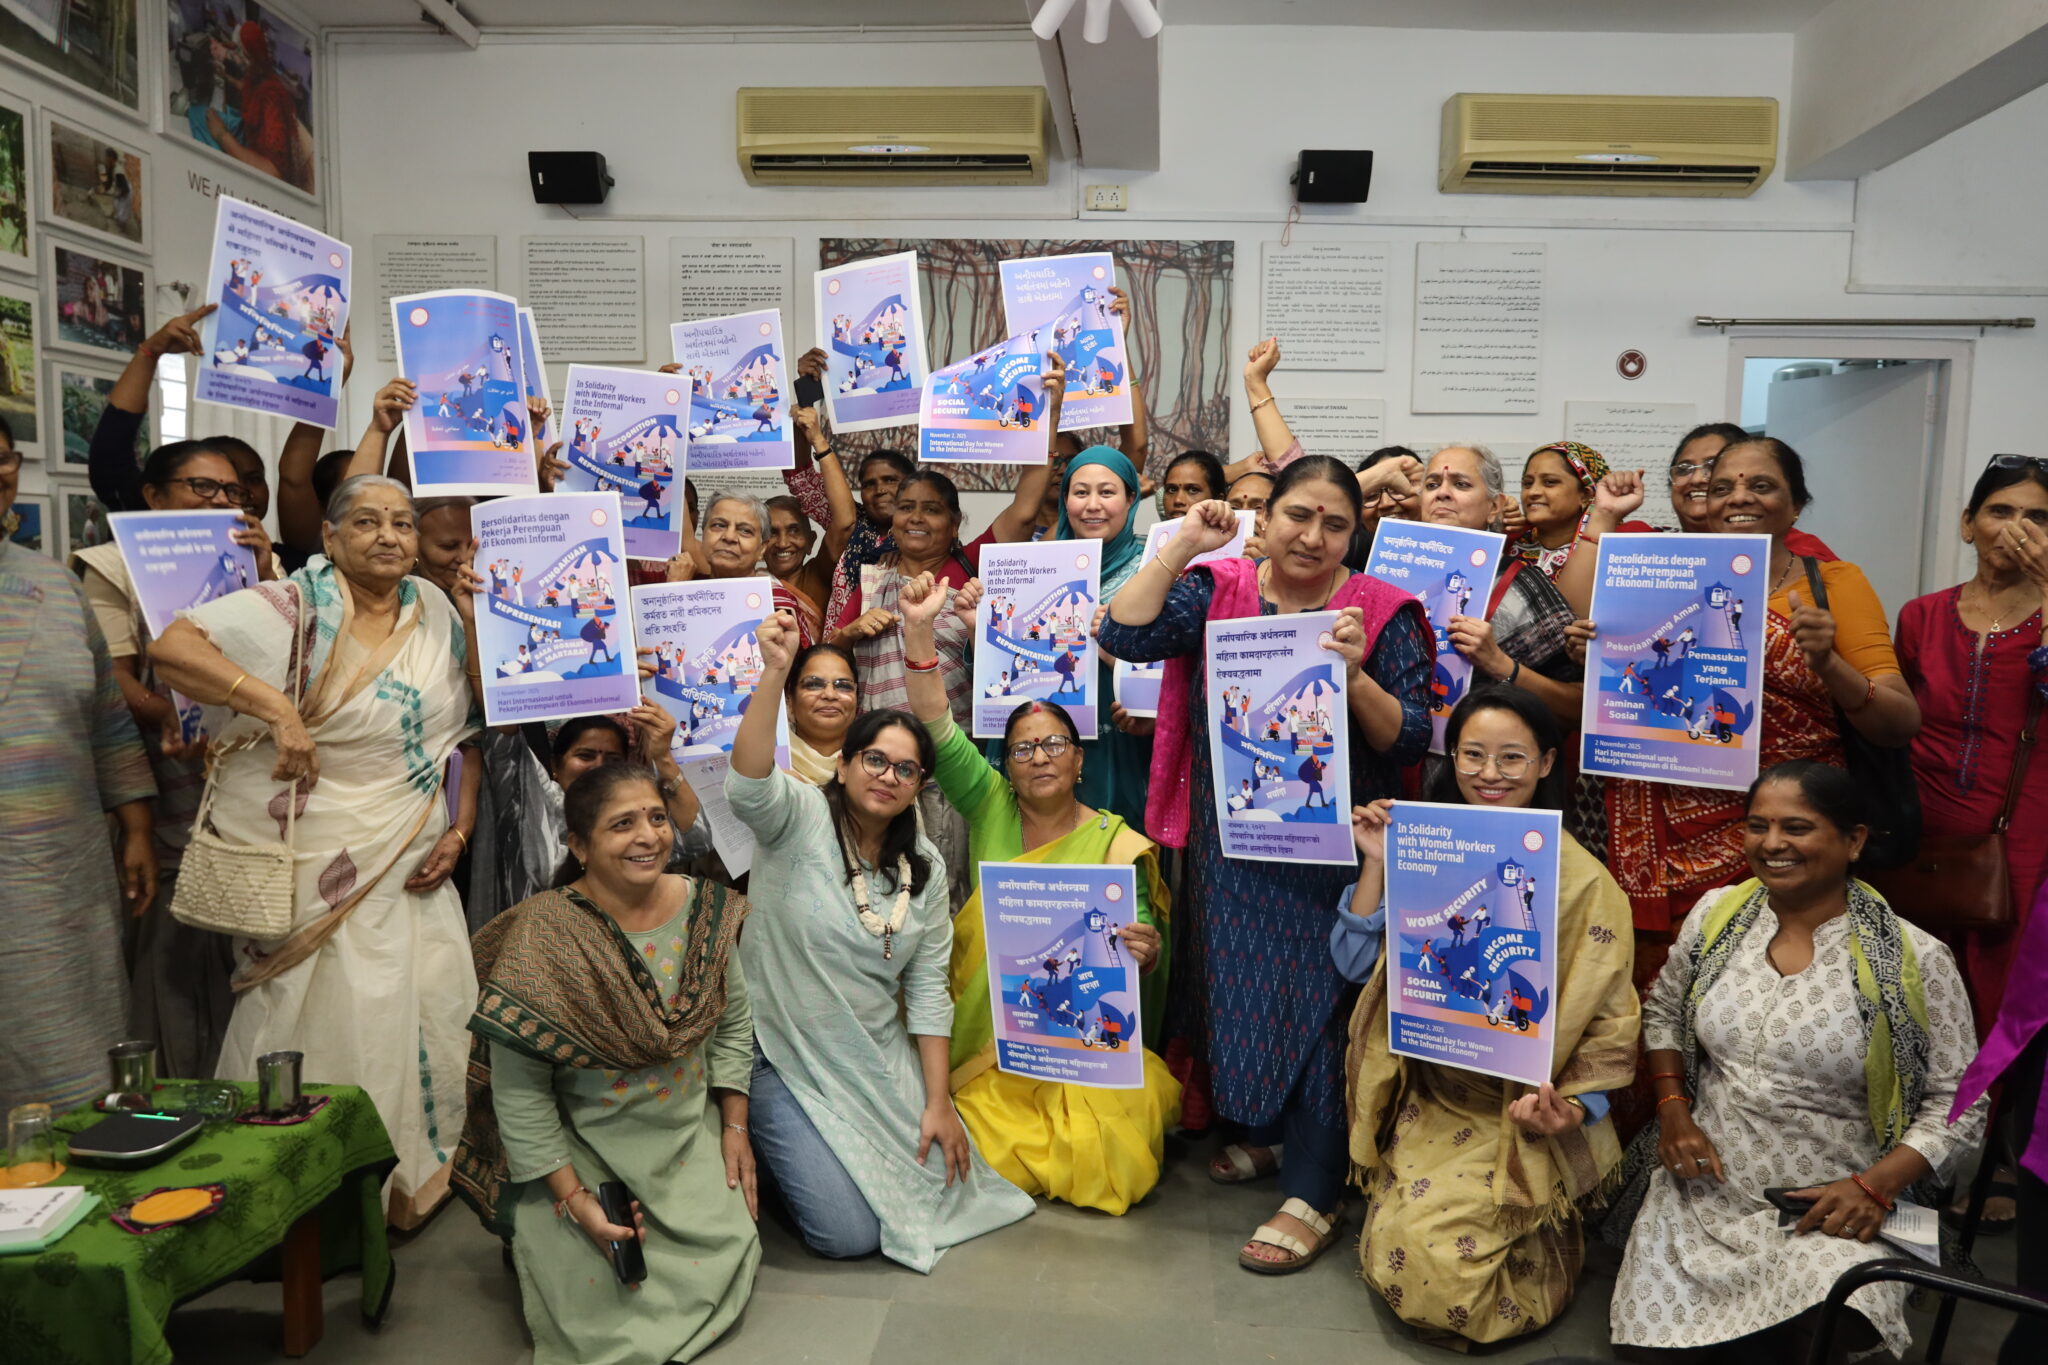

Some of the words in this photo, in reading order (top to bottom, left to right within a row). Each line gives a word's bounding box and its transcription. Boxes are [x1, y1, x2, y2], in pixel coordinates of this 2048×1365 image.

[187, 169, 211, 198] WE
[998, 356, 1030, 378] INCOME
[1002, 365, 1038, 388] SECURITY
[576, 380, 584, 388] In
[584, 381, 616, 393] Solidarity
[574, 398, 581, 406] in
[581, 398, 593, 408] the
[593, 400, 624, 411] Informal
[575, 390, 590, 398] with
[591, 391, 617, 401] Women
[617, 393, 647, 405] Workers
[937, 398, 966, 406] SOCIAL
[572, 406, 602, 419] Economy
[932, 407, 970, 415] SECURITY
[608, 417, 658, 449] RECOGNITION
[929, 439, 965, 447] International
[965, 440, 975, 448] Day
[968, 447, 992, 455] Economy
[577, 455, 641, 489] REPRESENTATION
[481, 513, 537, 529] Bersolidaritas
[538, 512, 570, 525] dengan
[481, 526, 512, 539] Pekerja
[513, 523, 562, 536] Perempuan
[481, 540, 490, 549] di
[491, 536, 527, 546] Ekonomi
[528, 533, 566, 543] Informal
[538, 544, 588, 588] PENGAKUAN
[988, 559, 996, 568] In
[996, 558, 1028, 568] Solidarity
[1608, 553, 1669, 566] Bersolidaritas
[1670, 554, 1707, 568] dengan
[987, 568, 1002, 576] with
[1003, 567, 1028, 576] Women
[1029, 566, 1057, 575] Workers
[1607, 565, 1640, 578] Pekerja
[1640, 566, 1694, 580] Perempuan
[987, 577, 994, 585] in
[994, 576, 1006, 585] the
[1006, 576, 1035, 585] Informal
[1605, 576, 1614, 587] di
[1615, 578, 1655, 589] Ekonomi
[1655, 578, 1698, 591] Informal
[987, 586, 1016, 595] Economy
[1022, 585, 1069, 625] RECOGNITION
[494, 600, 562, 630] REPRESENTASI
[1605, 637, 1653, 653] Pekerjaan
[1651, 621, 1674, 641] yang
[1672, 601, 1701, 624] Aman
[995, 635, 1057, 663] REPRESENTATION
[1215, 651, 1238, 663] महिला
[1687, 650, 1747, 663] Pemasukan
[1701, 664, 1728, 675] yang
[1693, 674, 1739, 687] Terjamin
[497, 697, 511, 706] Hari
[512, 695, 554, 706] Internasional
[555, 693, 573, 702] untuk
[498, 704, 523, 713] Pekerja
[523, 702, 559, 712] Perempuan
[559, 700, 566, 708] di
[566, 698, 593, 708] Ekonomi
[593, 695, 621, 705] Informal
[1603, 699, 1646, 710] Jaminan
[1608, 710, 1639, 721] Sosial
[1599, 740, 1627, 749] November
[1628, 742, 1641, 750] 2025
[1594, 748, 1609, 757] Hari
[1610, 749, 1657, 762] Internasional
[1657, 754, 1679, 764] untuk
[1594, 756, 1620, 766] Pekerja
[1620, 758, 1661, 770] Perempuan
[1661, 761, 1670, 771] di
[1670, 763, 1701, 775] Ekonomi
[1701, 766, 1735, 778] Informal
[1397, 822, 1407, 834] In
[1408, 823, 1453, 840] Solidarity
[1397, 835, 1418, 847] with
[1419, 837, 1454, 850] Women
[1455, 840, 1496, 854] Workers
[1397, 846, 1407, 857] in
[1408, 848, 1423, 860] the
[1424, 849, 1465, 864] Informal
[1397, 859, 1438, 877] Economy
[1405, 912, 1444, 928] WORK
[1443, 878, 1489, 919] SECURITY
[1482, 933, 1524, 960] INCOME
[1488, 946, 1536, 974] SECURITY
[1406, 976, 1442, 990] SOCIAL
[1402, 987, 1448, 1003] SECURITY
[1400, 1018, 1425, 1030] November
[1426, 1023, 1432, 1032] 2,
[1432, 1024, 1445, 1034] 2025
[1400, 1028, 1443, 1044] International
[1443, 1036, 1457, 1047] Day
[1456, 1038, 1468, 1048] for
[1468, 1040, 1494, 1053] Women
[1400, 1035, 1408, 1044] in
[1408, 1037, 1419, 1046] the
[1419, 1039, 1448, 1053] Informal
[1448, 1045, 1479, 1060] Economy
